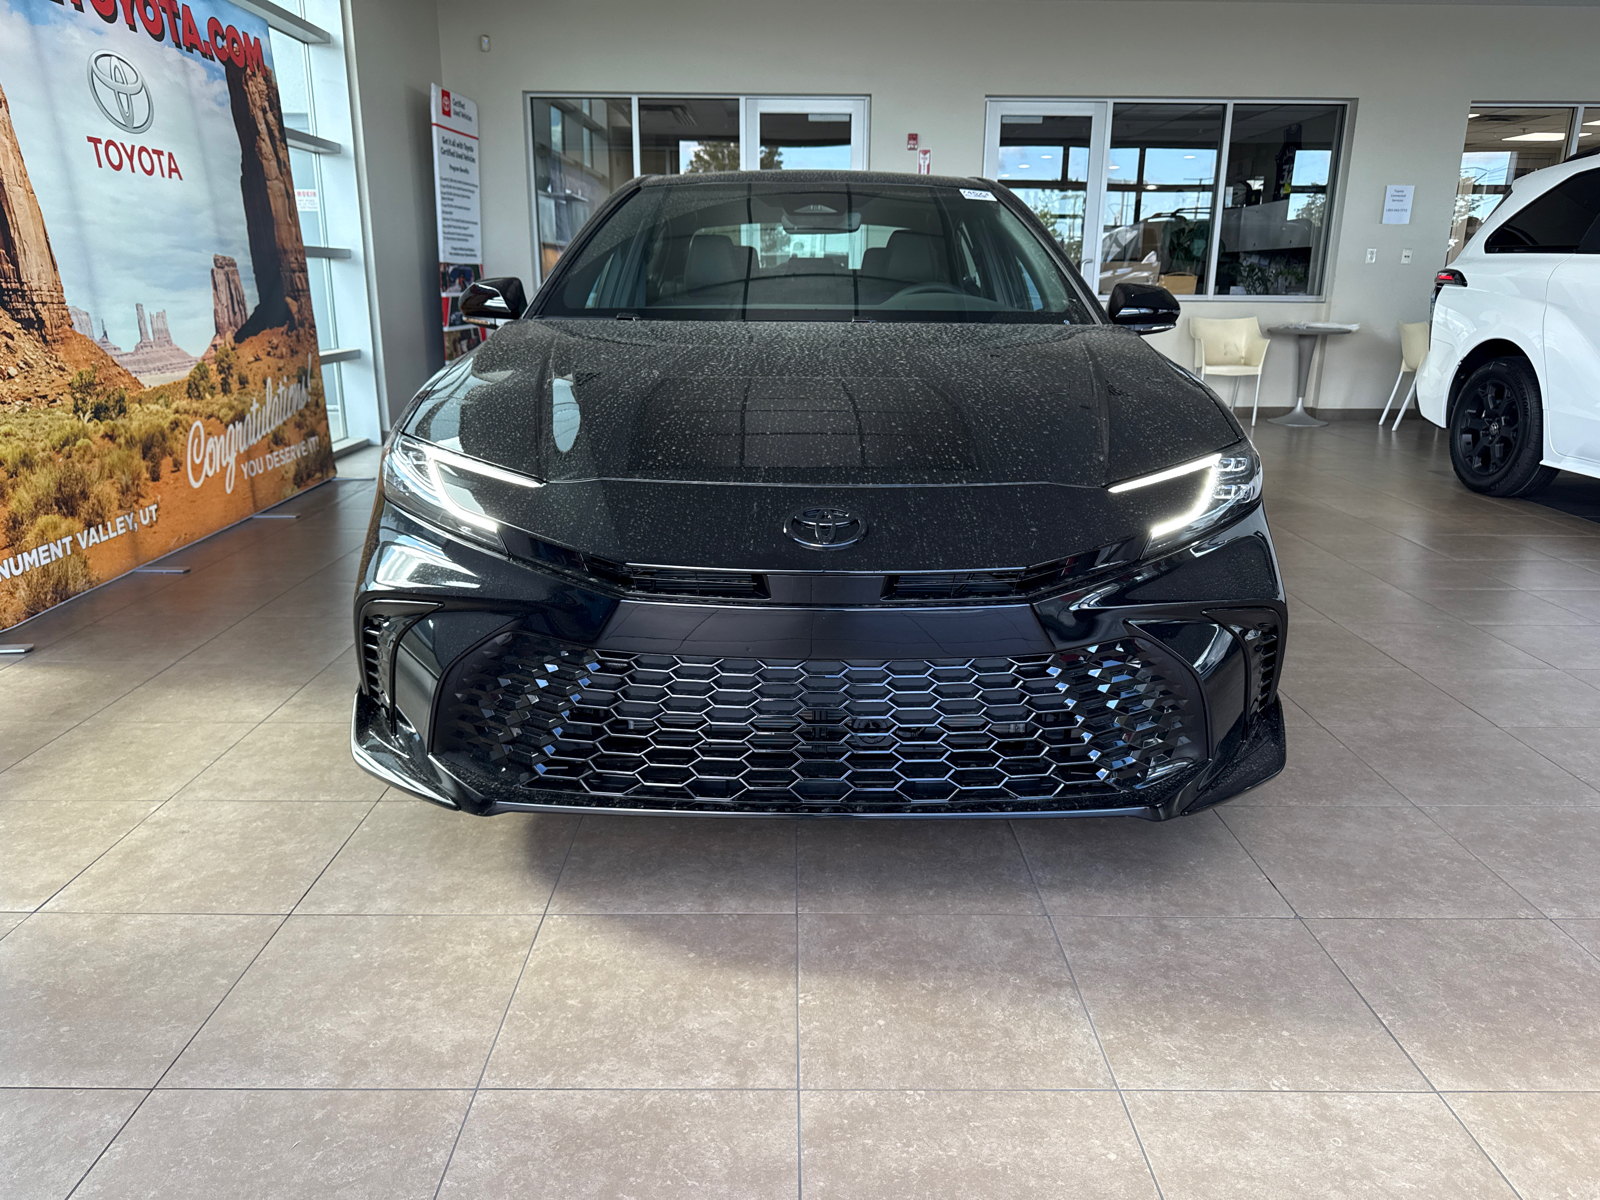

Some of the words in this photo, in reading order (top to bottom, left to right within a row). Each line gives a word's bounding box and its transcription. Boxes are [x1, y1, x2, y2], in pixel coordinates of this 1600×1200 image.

[86, 135, 183, 181] TOYOTA
[187, 352, 312, 494] Congratulations!
[240, 457, 264, 479] YOU
[265, 439, 308, 471] DESERVE
[76, 512, 138, 550] VALLEY,
[139, 503, 158, 525] UT
